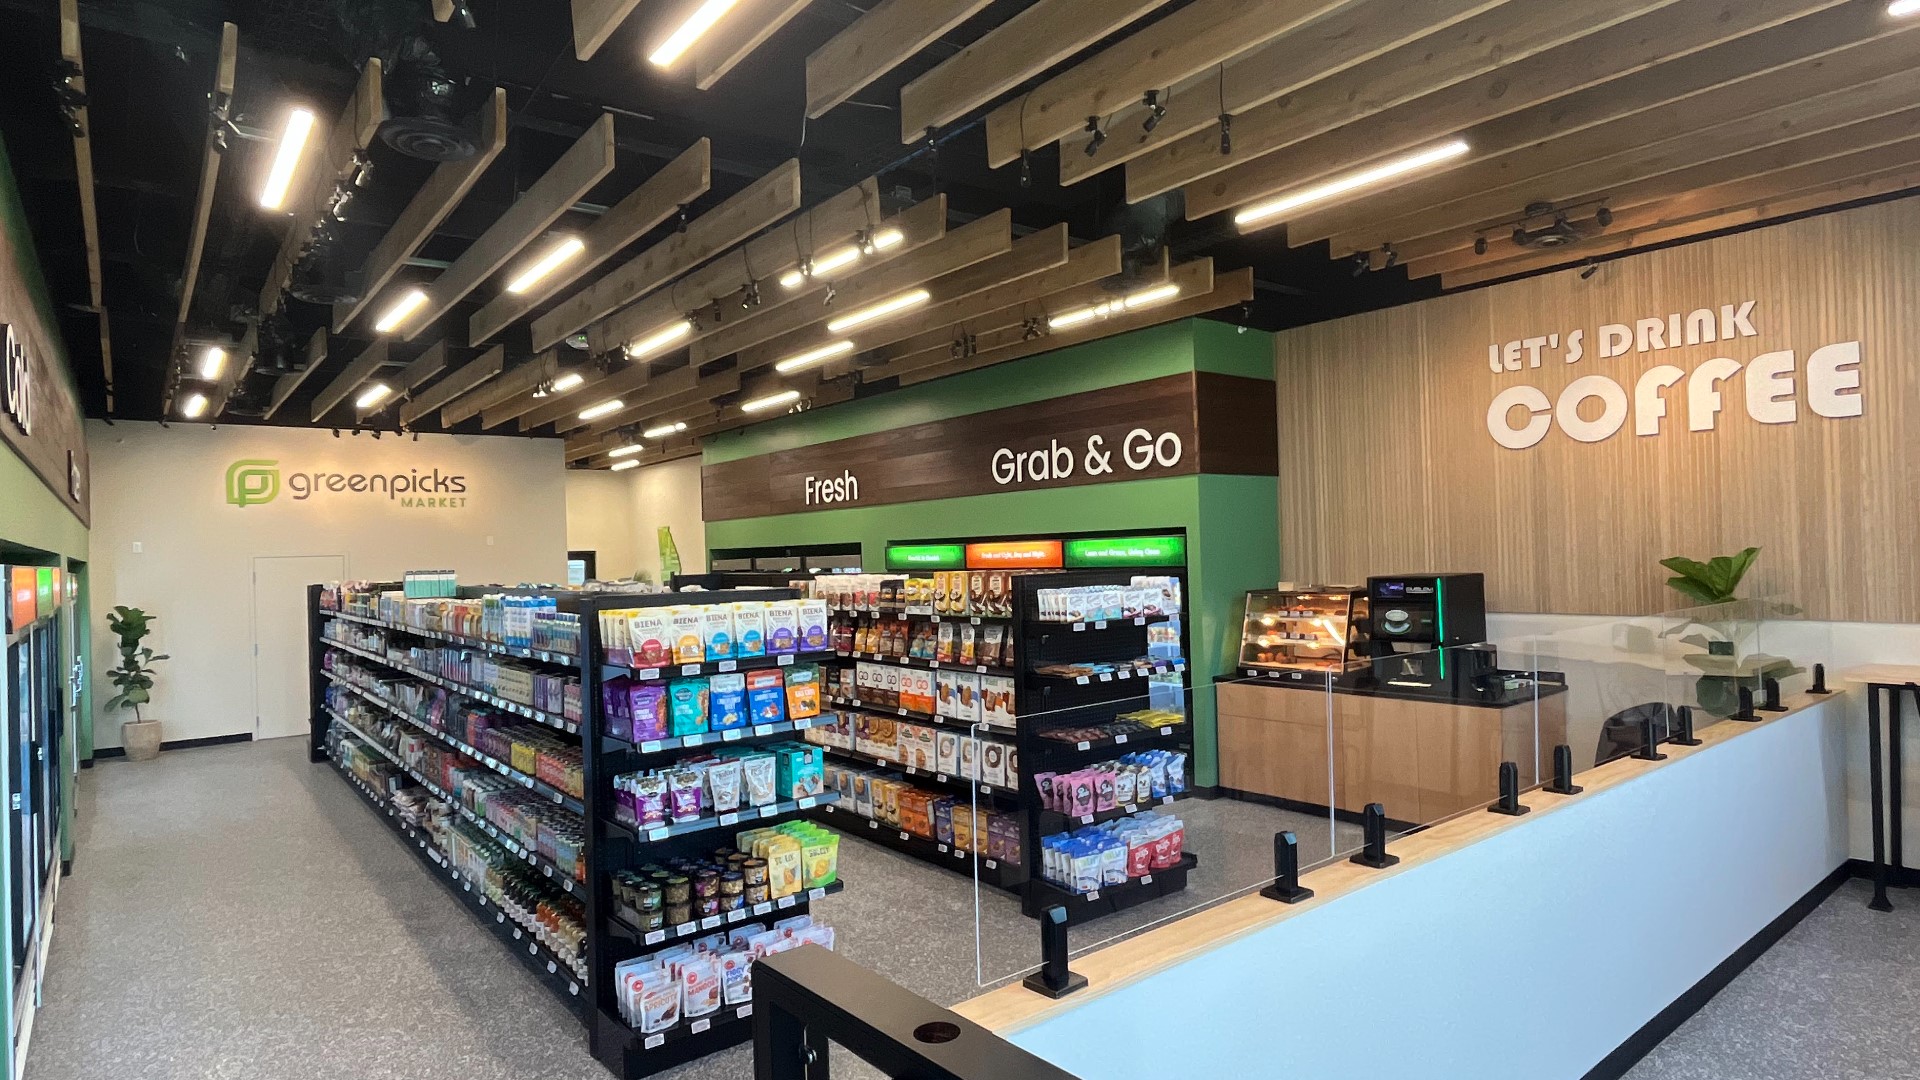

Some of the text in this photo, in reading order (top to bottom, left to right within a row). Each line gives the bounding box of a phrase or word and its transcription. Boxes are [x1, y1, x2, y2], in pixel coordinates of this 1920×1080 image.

[1488, 300, 1758, 373] LET'S DRINK
[4, 323, 31, 437] Cold
[1486, 341, 1863, 449] COFFEE
[991, 428, 1182, 485] Grab & Go
[288, 468, 467, 500] greenpicks
[805, 470, 858, 505] Fresh
[401, 497, 467, 508] MARKET
[738, 611, 760, 620] BIENA
[769, 608, 793, 617] BIENA
[802, 606, 823, 615] BIENA
[673, 616, 699, 625] BIENA
[706, 613, 728, 621] BIENA
[634, 618, 663, 628] BIENA
[858, 670, 869, 681] GO
[872, 672, 882, 683] GO
[886, 674, 897, 685] GO
[901, 677, 912, 688] GO
[916, 679, 928, 691] GO
